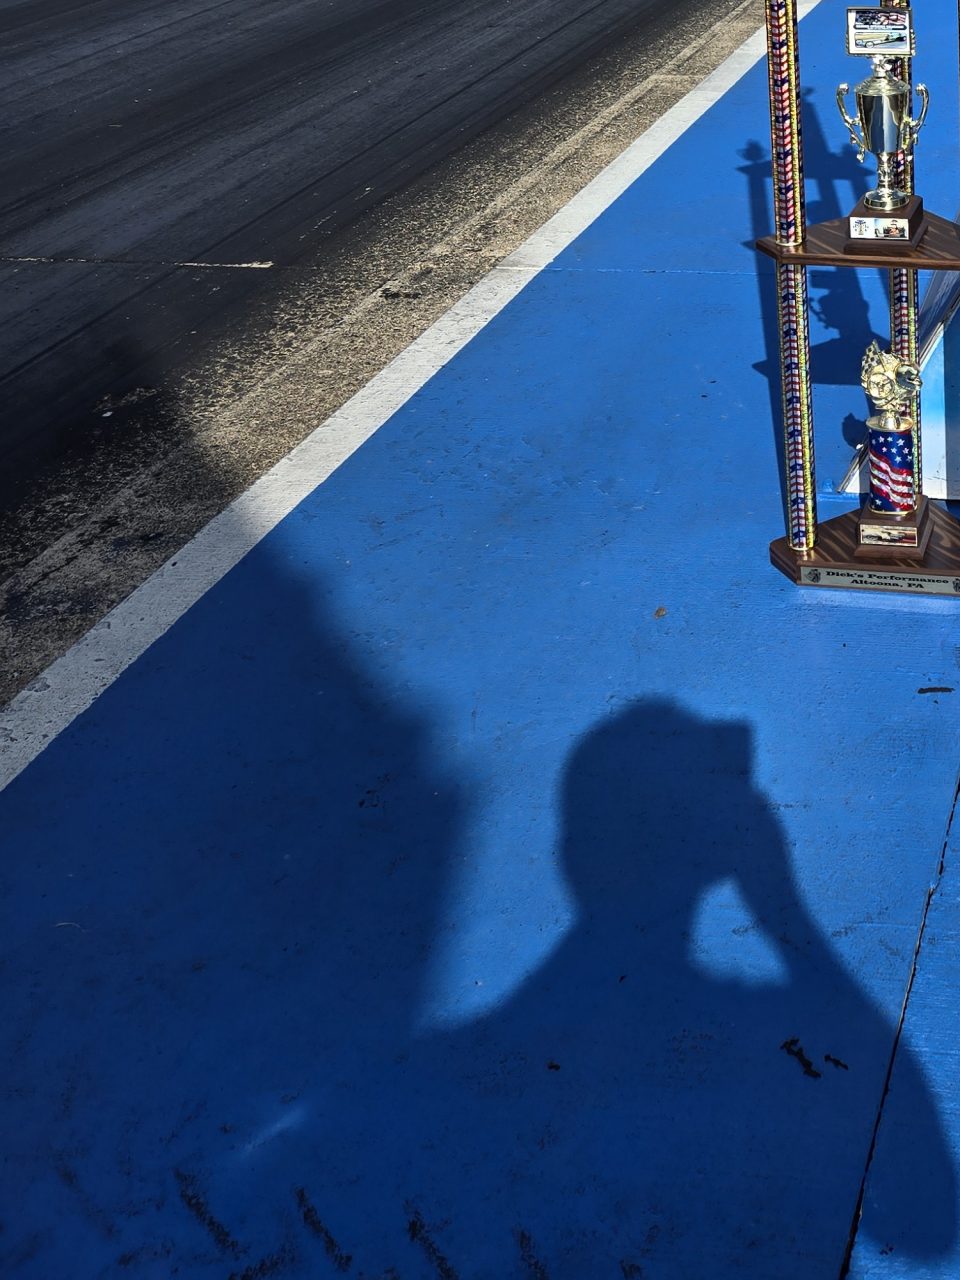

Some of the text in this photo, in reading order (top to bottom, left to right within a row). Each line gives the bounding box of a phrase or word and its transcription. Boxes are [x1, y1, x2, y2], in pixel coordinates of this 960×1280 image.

[825, 570, 949, 584] Dick's Performance
[850, 579, 903, 588] Altoona,
